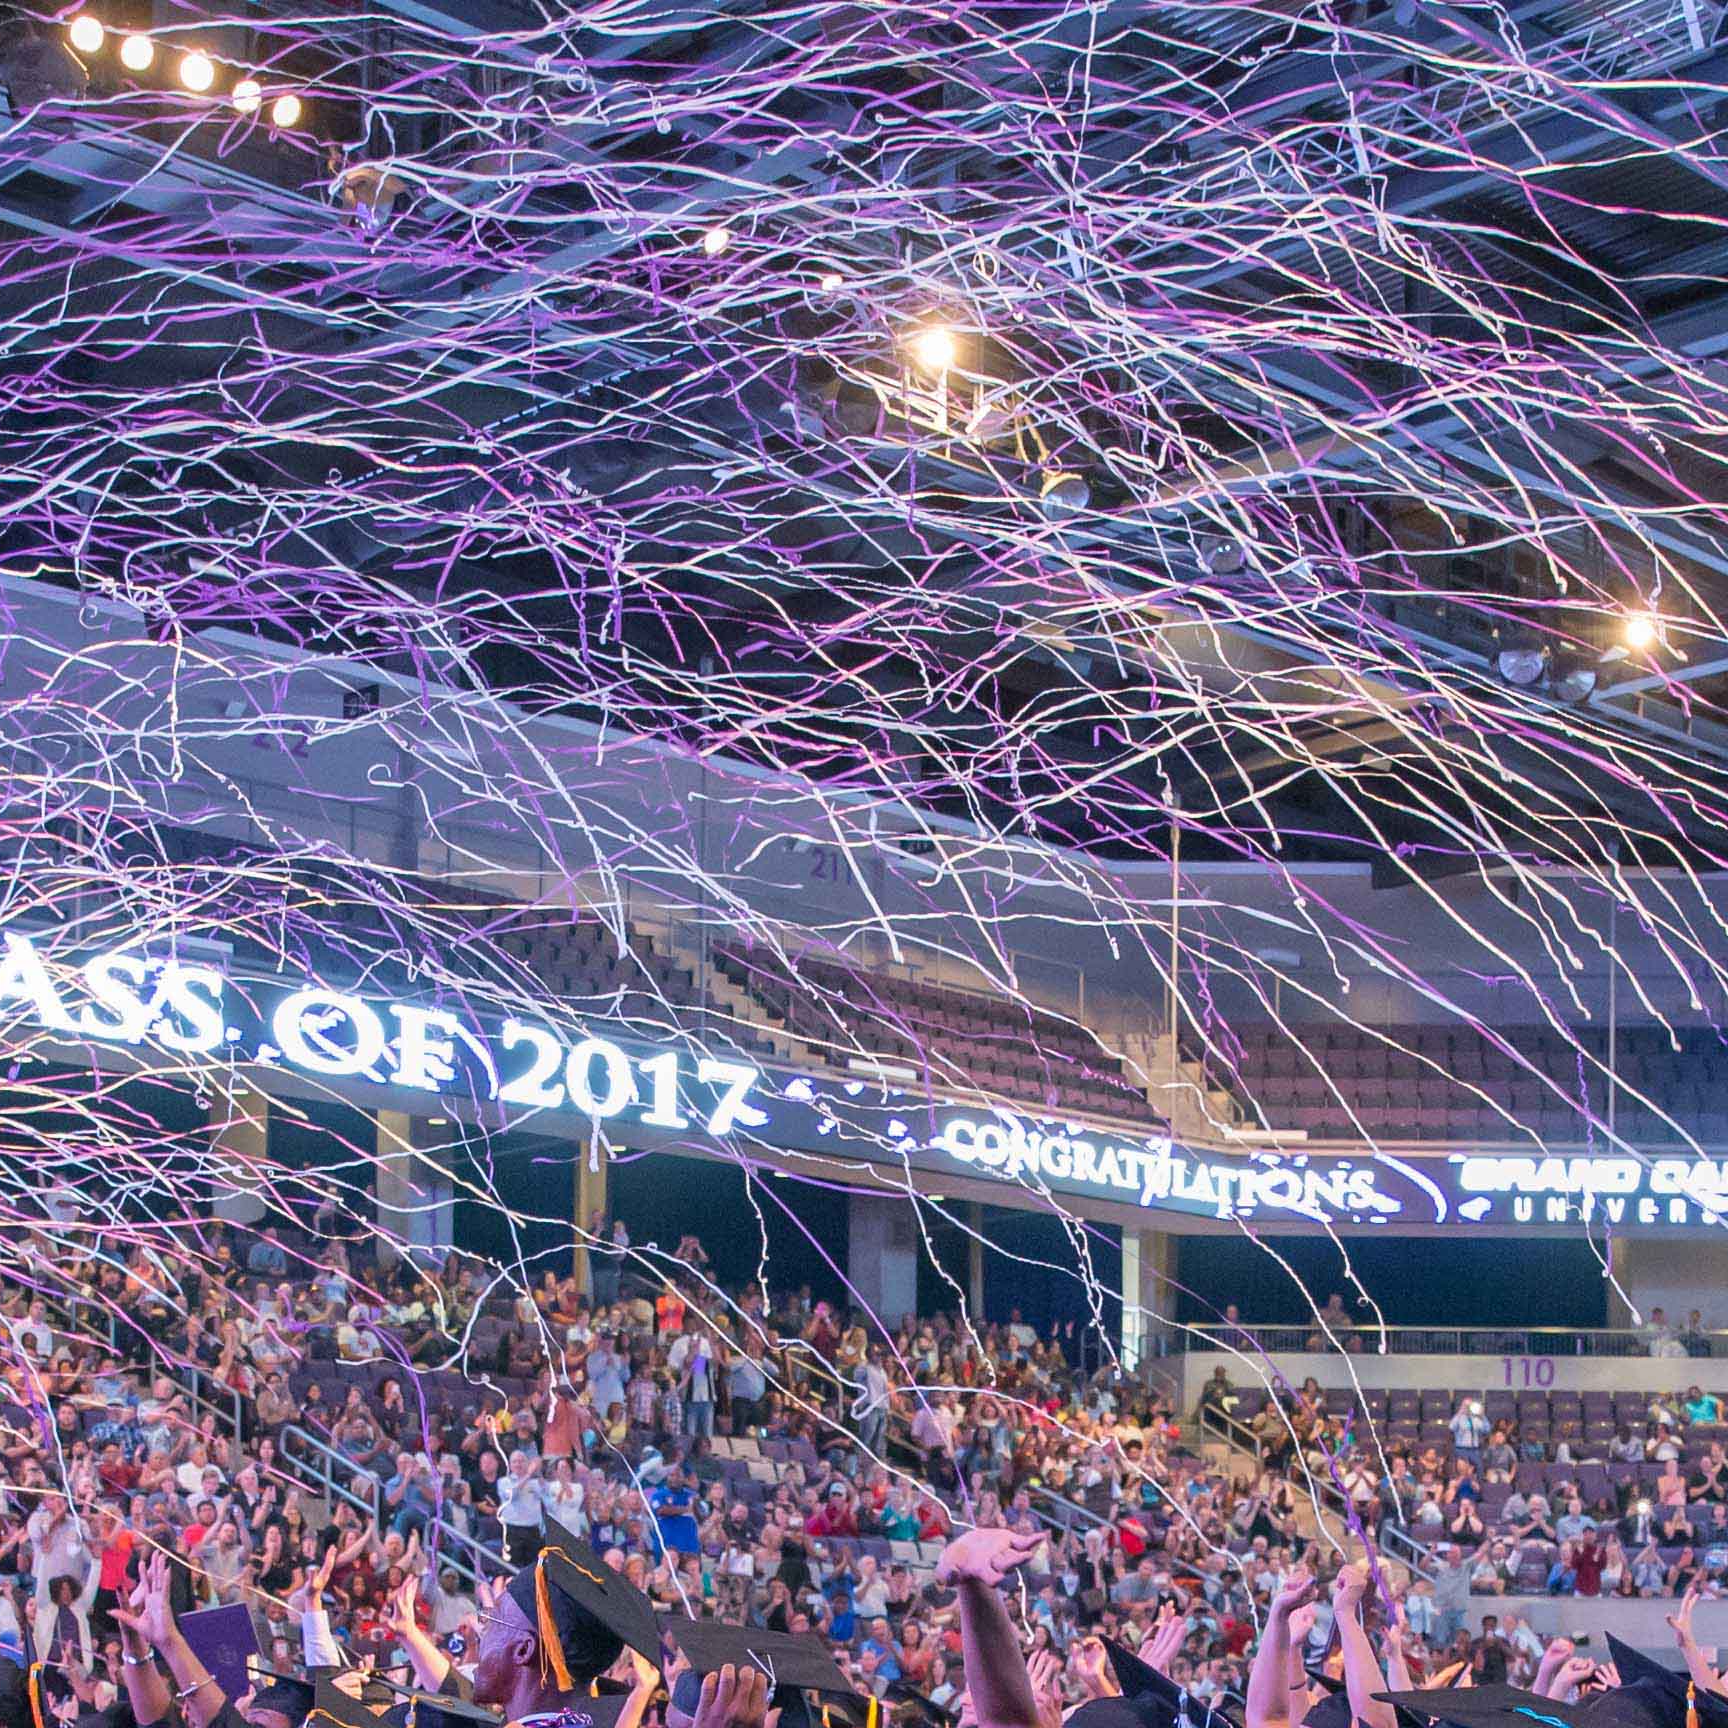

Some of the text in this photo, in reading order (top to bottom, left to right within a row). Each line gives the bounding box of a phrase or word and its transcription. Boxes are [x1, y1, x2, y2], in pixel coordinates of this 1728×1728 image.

[271, 985, 457, 1090] OF
[499, 1017, 760, 1135] 2017
[943, 1119, 1376, 1210] CONGRATULATIONS
[1460, 1158, 1642, 1192] GRAND
[1502, 1357, 1555, 1387] 110
